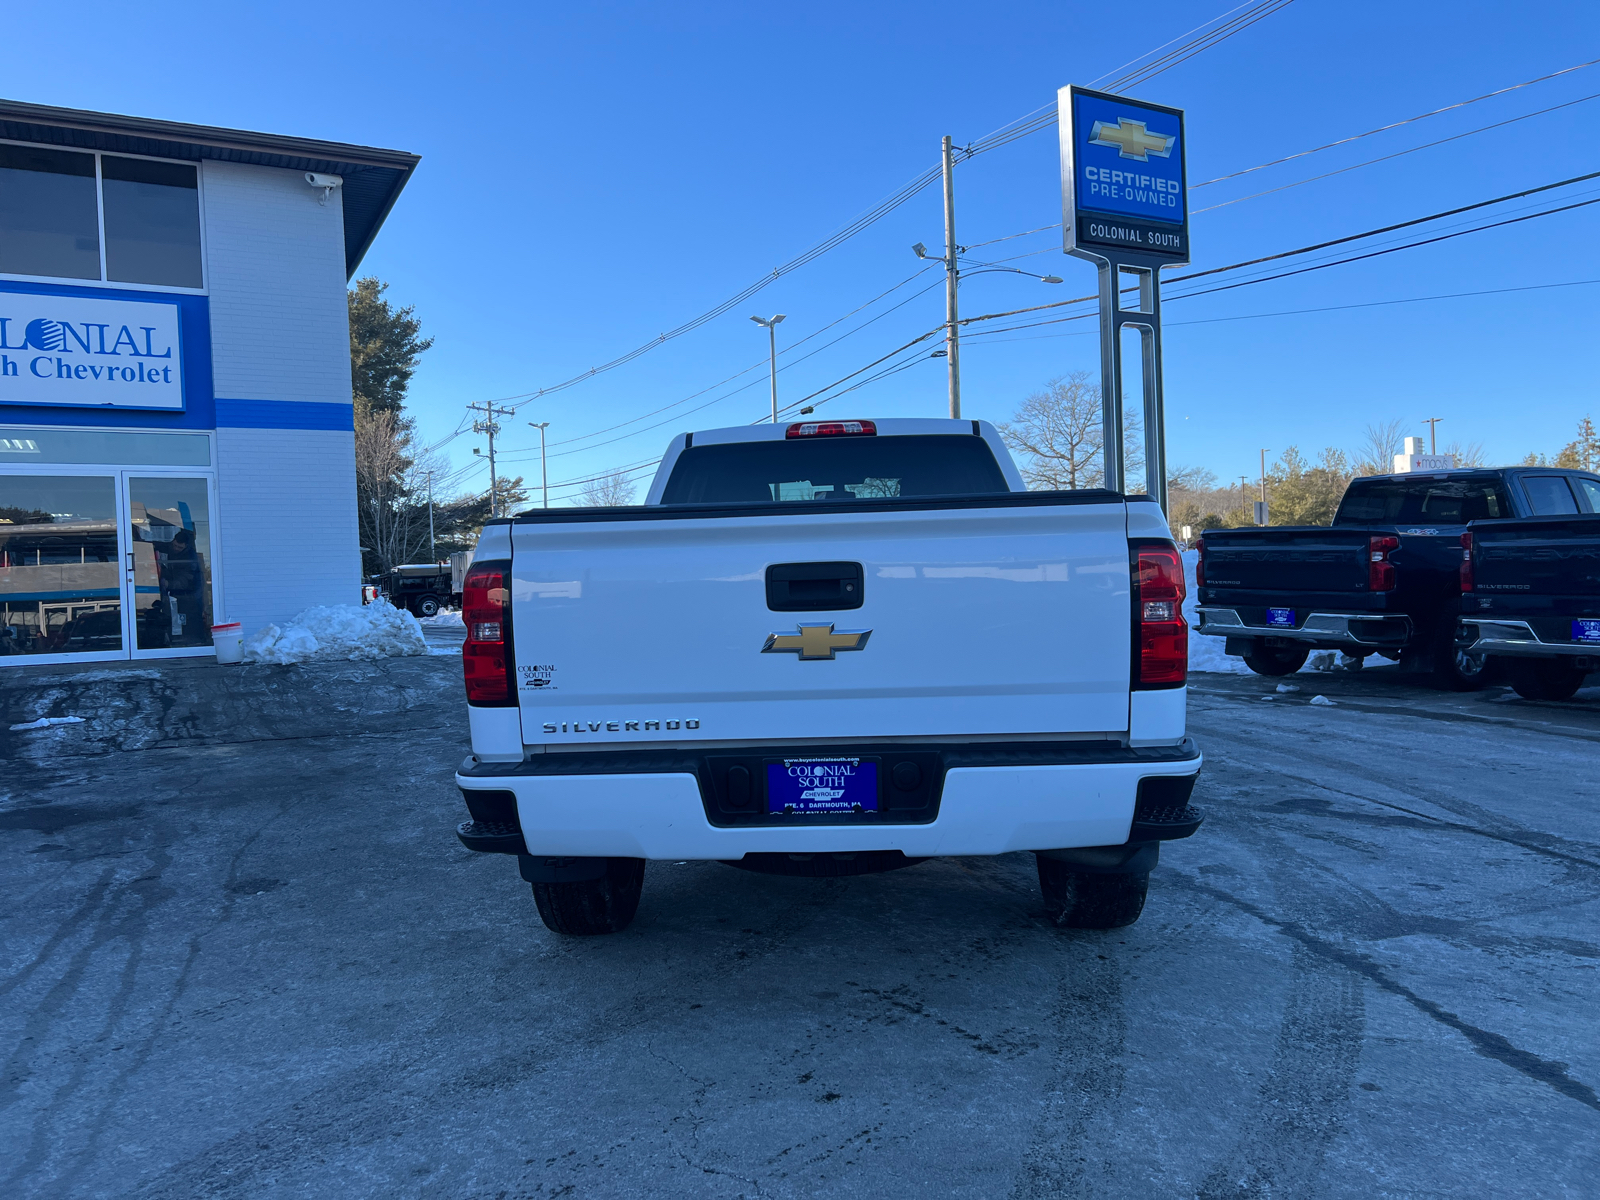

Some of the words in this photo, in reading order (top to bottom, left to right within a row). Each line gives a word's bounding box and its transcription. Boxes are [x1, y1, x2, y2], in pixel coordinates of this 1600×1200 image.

[1085, 166, 1179, 194] CERTIFIED
[1091, 182, 1176, 207] PRE-OWNED
[1090, 224, 1142, 243] COLONIAL
[1148, 231, 1180, 248] SOUTH
[29, 355, 172, 384] Chevrolet
[1421, 457, 1448, 469] macy's
[517, 664, 557, 672] COLONIAL
[542, 718, 700, 734] SILVERADO
[788, 765, 855, 777] COLONIAL
[799, 776, 845, 788] SOUTH
